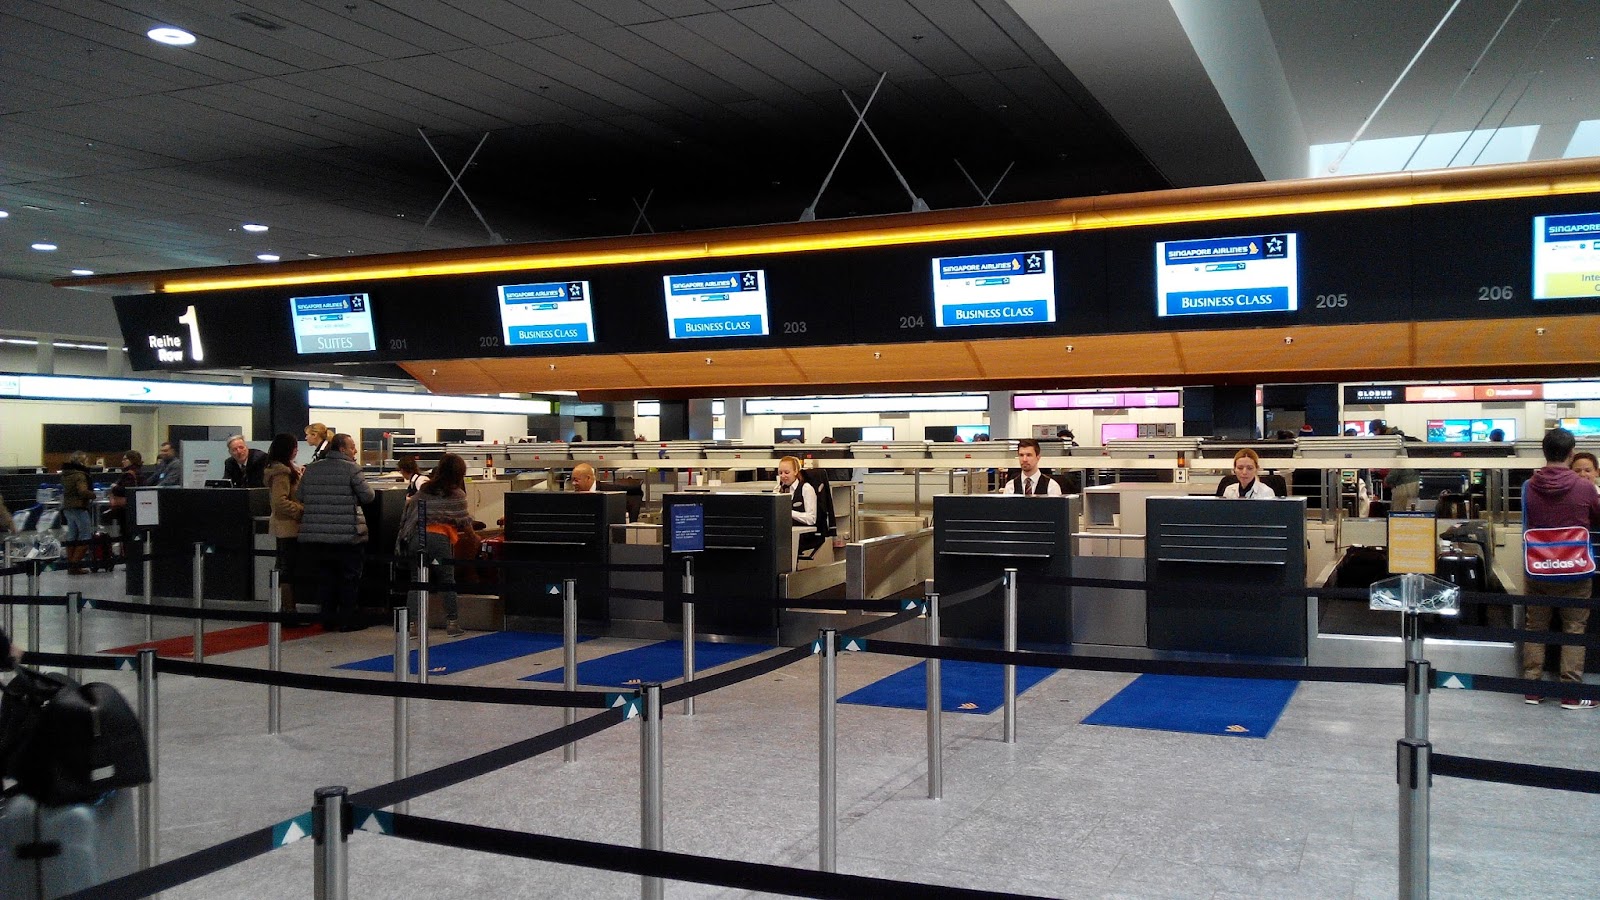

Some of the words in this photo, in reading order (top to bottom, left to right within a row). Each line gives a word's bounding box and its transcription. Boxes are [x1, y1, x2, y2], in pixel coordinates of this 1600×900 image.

[1548, 224, 1600, 233] SINGAPORE
[1168, 247, 1212, 258] SINGAPORE
[1212, 245, 1248, 255] AIRLINES
[942, 264, 980, 272] SINGAPORE
[981, 262, 1012, 270] AIRLINES
[672, 281, 704, 289] SINGAPORE
[506, 291, 535, 299] SINGAPORE
[1478, 286, 1513, 301] 206
[1181, 296, 1234, 309] BUSINESS
[1236, 294, 1272, 306] CLASS
[1316, 294, 1348, 309] 205
[955, 309, 1001, 320] BUSINESS
[1002, 307, 1034, 318] CLASS
[685, 322, 723, 332] BUSINESS
[724, 321, 751, 331] CLASS
[783, 322, 807, 333] 203
[899, 316, 924, 328] 204
[179, 305, 204, 361] 1
[518, 329, 553, 339] BUSINESS
[554, 328, 578, 338] CLASS
[149, 335, 181, 348] Reihe
[317, 336, 353, 350] SUITES
[390, 339, 407, 350] 201
[480, 336, 498, 347] 202
[158, 349, 183, 361] Row
[1533, 559, 1574, 569] adidas
